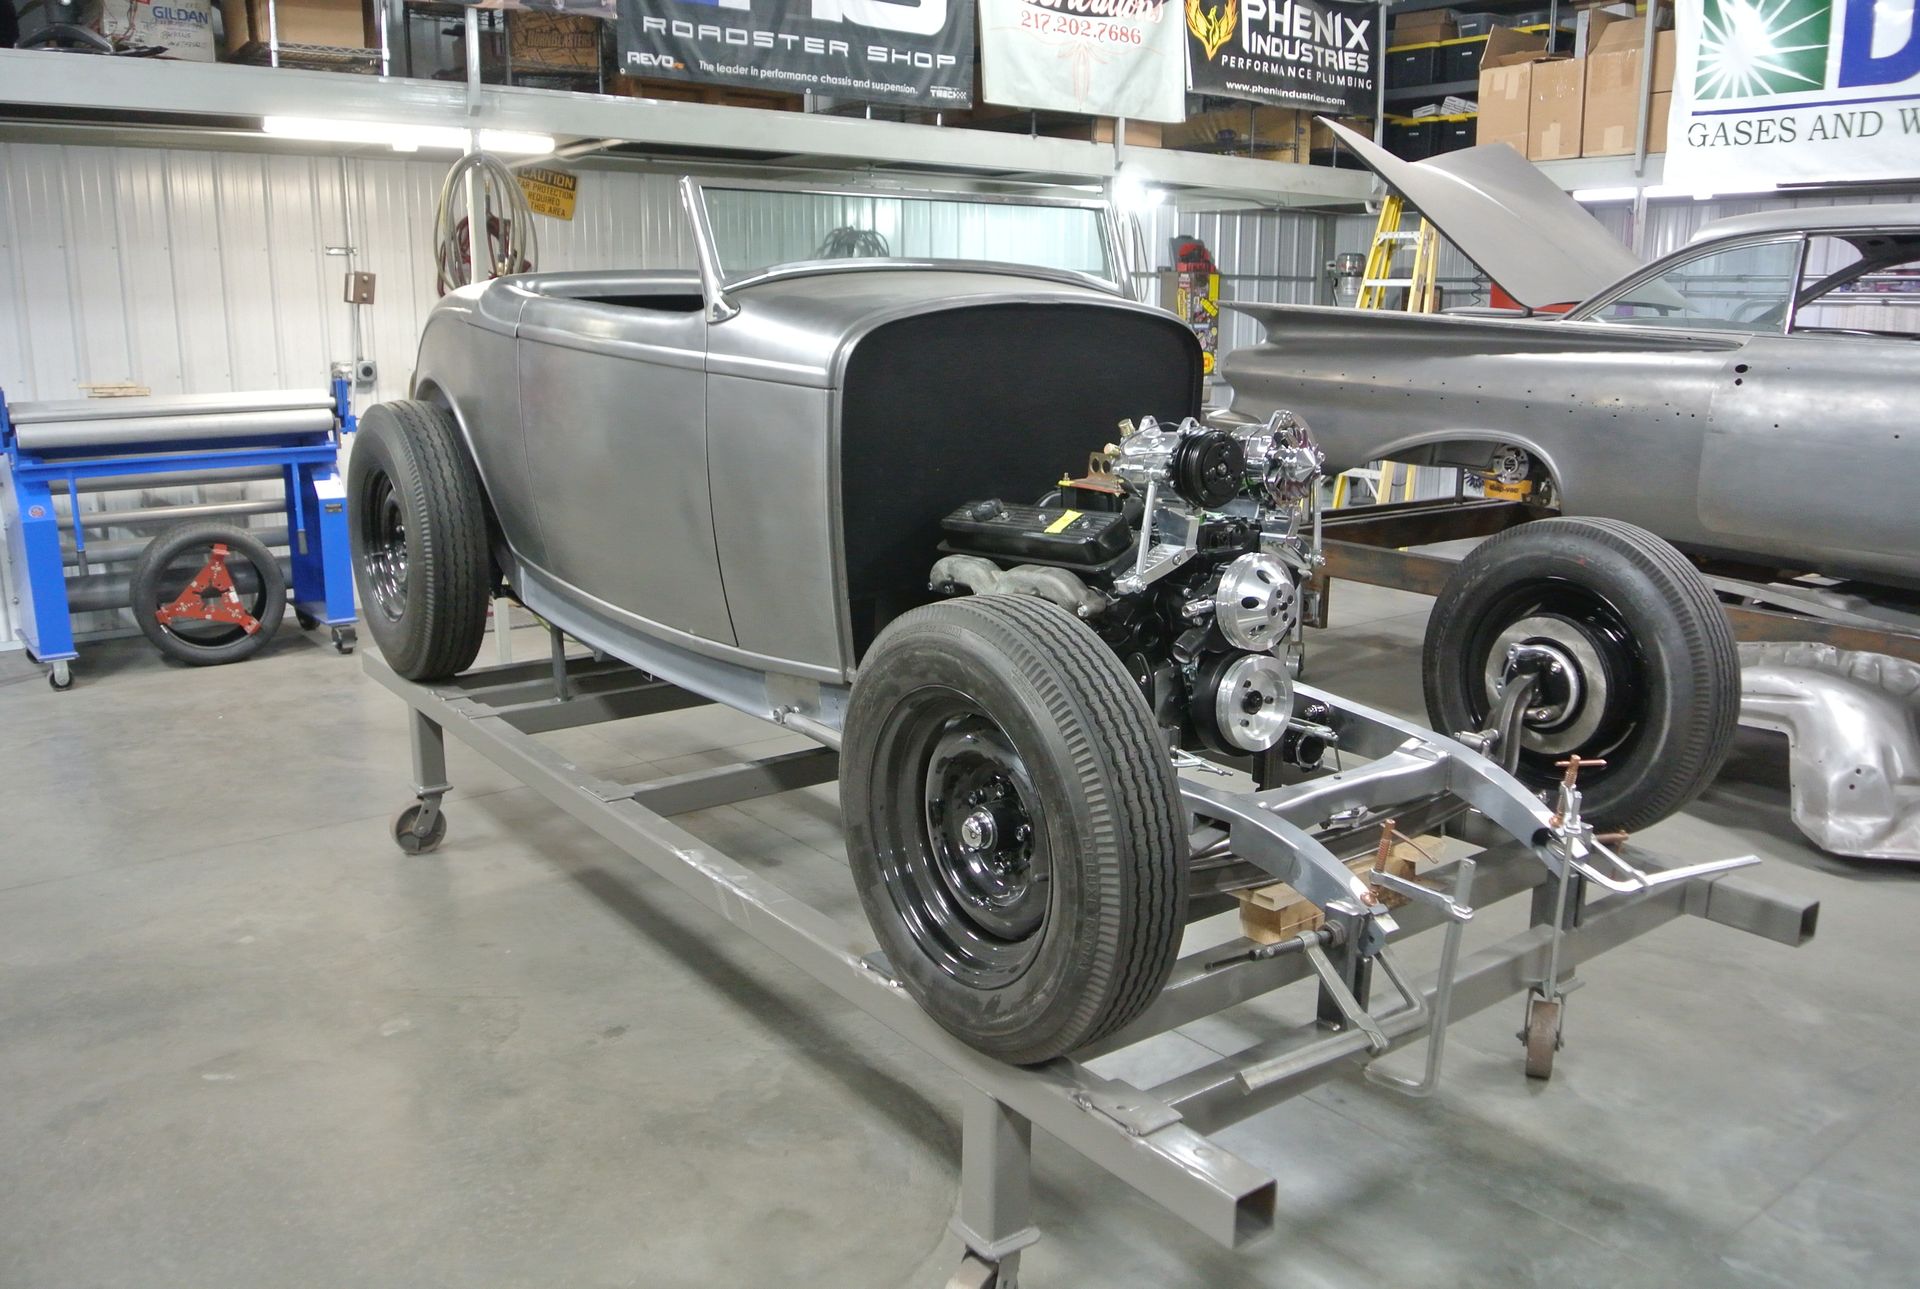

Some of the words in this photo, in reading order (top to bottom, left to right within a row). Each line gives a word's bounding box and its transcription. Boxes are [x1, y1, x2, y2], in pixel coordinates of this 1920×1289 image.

[153, 6, 209, 24] GILDAN
[1021, 10, 1142, 45] 217.202.7686
[1241, 0, 1371, 53] PHENIX
[643, 16, 849, 57] ROADSTER
[867, 45, 957, 69] SHOP
[1251, 31, 1370, 73] INDUSTRIES
[627, 51, 674, 68] REVO
[1221, 55, 1312, 81] PERFORMANCE
[1316, 71, 1372, 90] PLUMBING
[699, 60, 715, 72] The
[717, 63, 748, 76] leader
[750, 65, 759, 77] in
[760, 67, 818, 83] performance
[820, 74, 852, 87] chassis
[853, 78, 870, 89] and
[872, 81, 919, 95] suspension.
[1225, 81, 1346, 106] www.phenindustries.com
[1688, 117, 1797, 147] GASES
[1808, 111, 1884, 140] AND
[521, 167, 574, 189] CAUTION
[532, 182, 574, 200] PROTECTION
[527, 191, 560, 206] REQUIRED
[531, 201, 545, 212] THIS
[548, 206, 566, 217] AREA
